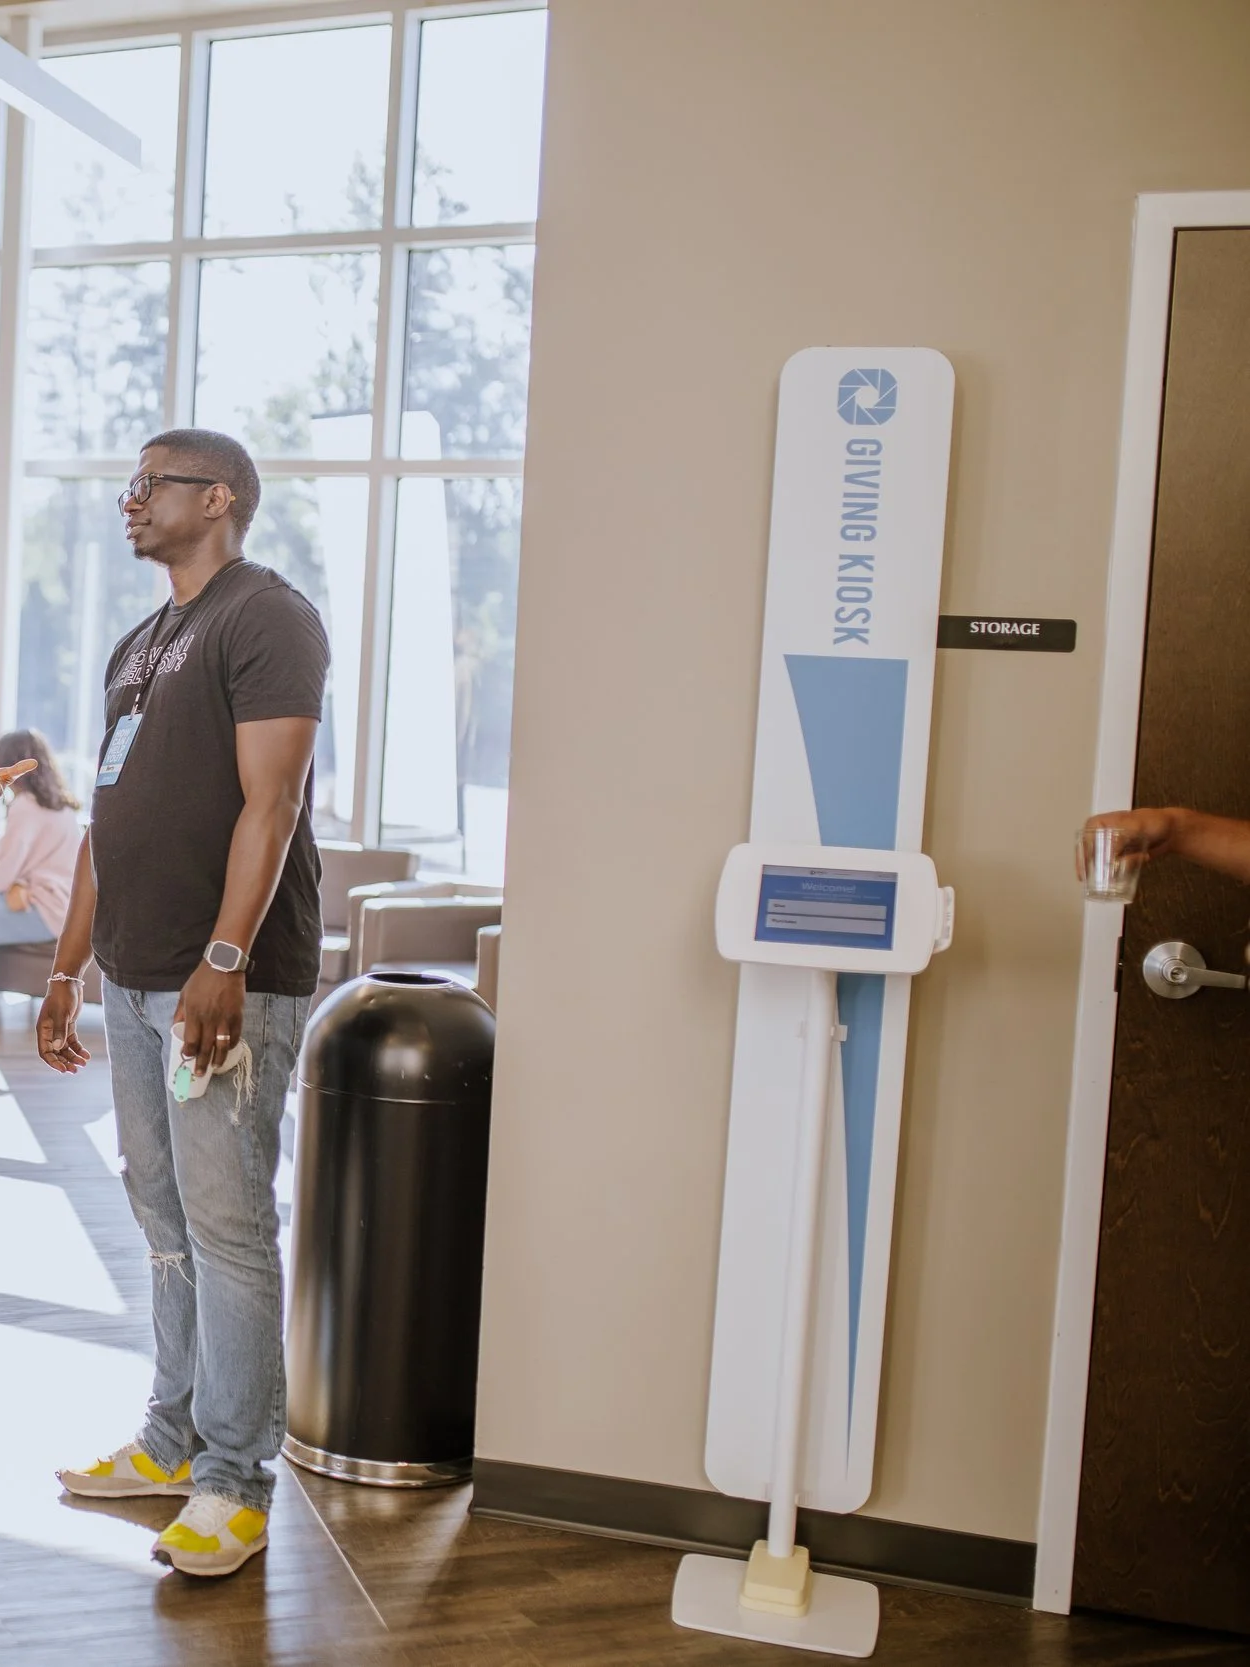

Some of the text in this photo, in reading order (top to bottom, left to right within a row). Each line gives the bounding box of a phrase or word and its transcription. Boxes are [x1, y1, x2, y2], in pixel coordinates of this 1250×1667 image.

[832, 438, 883, 645] GIVING KIOSK
[969, 621, 1040, 635] STORAGE
